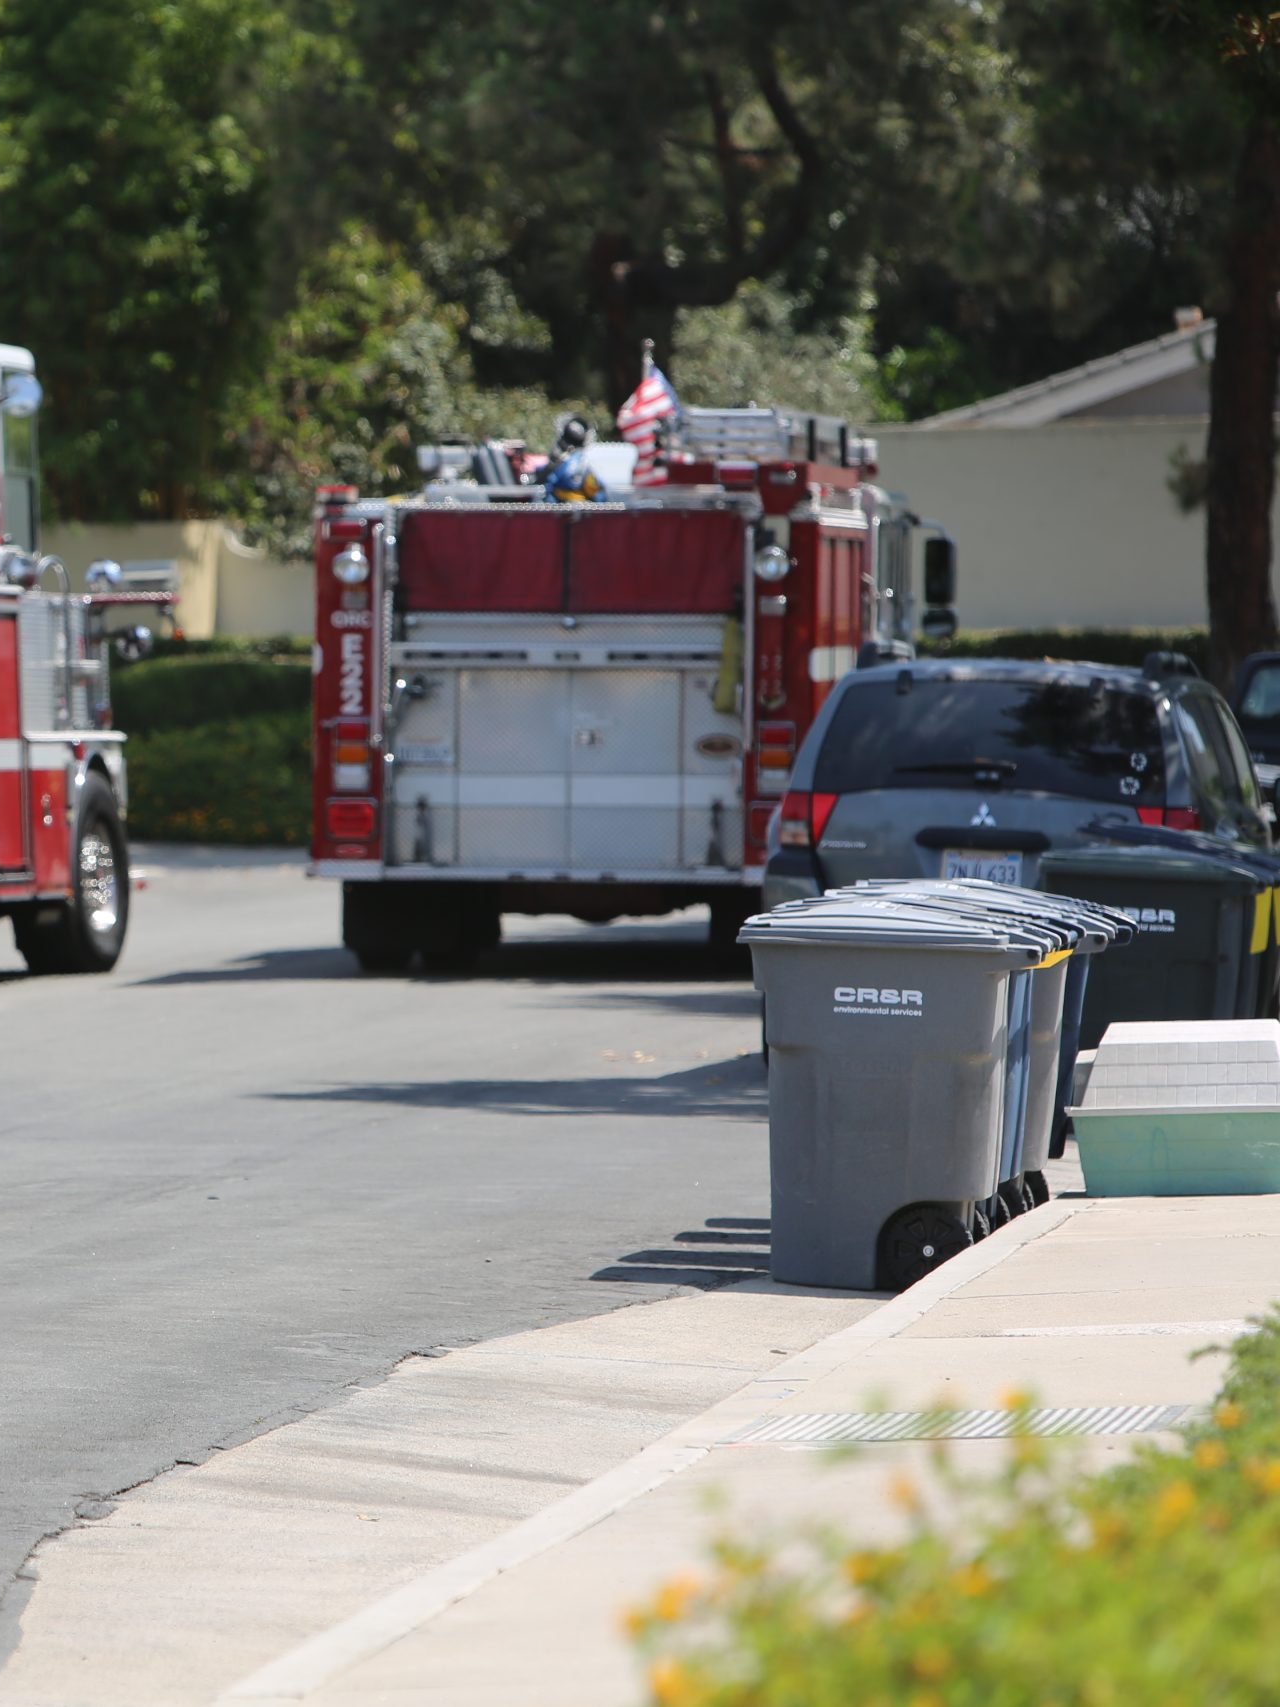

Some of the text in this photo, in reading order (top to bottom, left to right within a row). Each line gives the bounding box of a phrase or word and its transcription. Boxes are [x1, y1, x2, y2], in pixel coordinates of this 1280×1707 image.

[1111, 906, 1175, 924] R&R
[834, 987, 922, 1005] CR&R
[833, 1006, 922, 1016] environmental services
